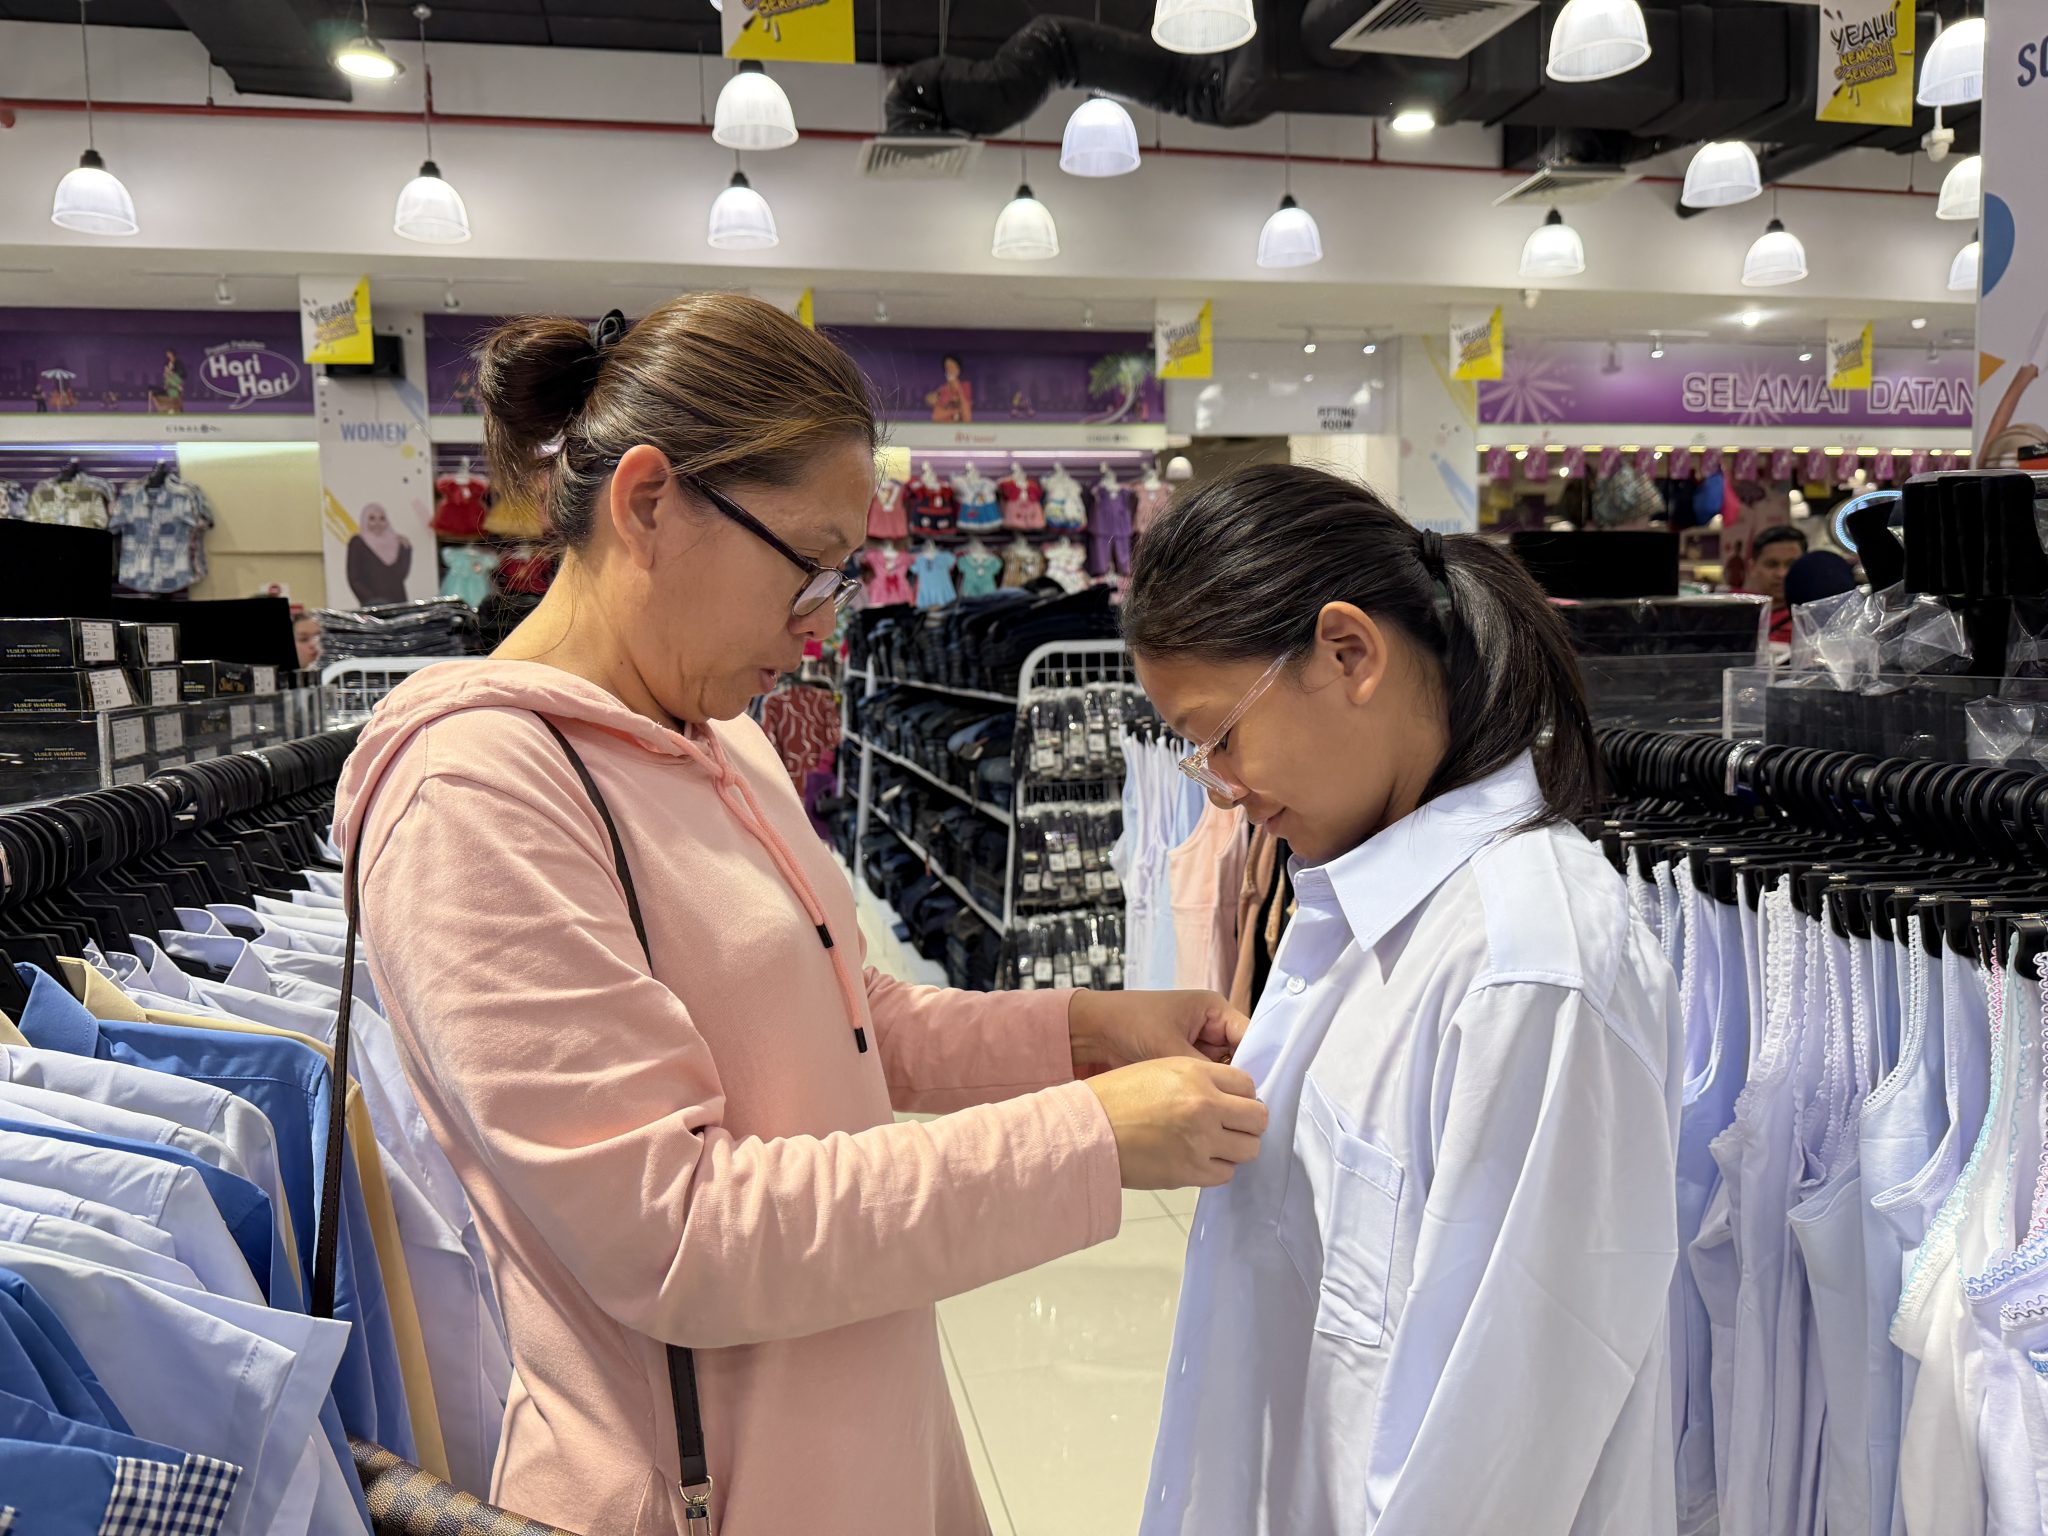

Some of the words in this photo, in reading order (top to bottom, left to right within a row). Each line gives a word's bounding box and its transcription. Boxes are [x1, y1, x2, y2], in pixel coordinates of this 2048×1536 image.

[1830, 10, 1895, 51] YEAH!
[1840, 41, 1892, 66] KEMBALI
[208, 353, 261, 378] Hari
[238, 372, 290, 397] Hari
[340, 422, 407, 442] WOMEN
[1321, 420, 1352, 430] ROOM
